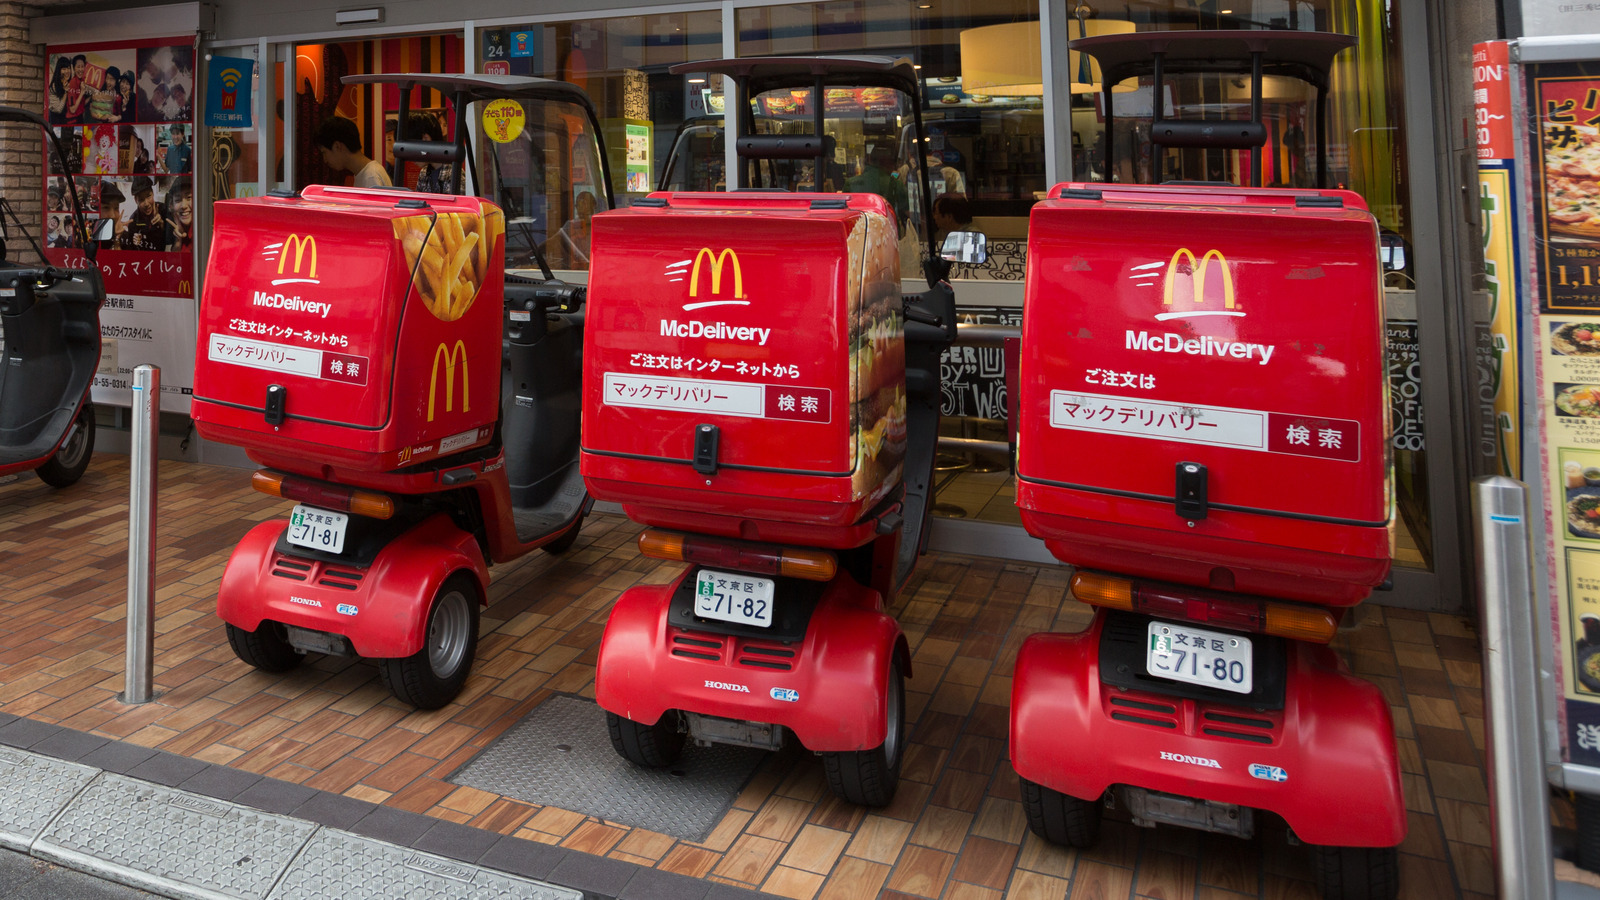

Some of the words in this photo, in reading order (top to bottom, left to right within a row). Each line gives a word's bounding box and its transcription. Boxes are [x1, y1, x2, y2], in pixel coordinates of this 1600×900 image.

[253, 291, 332, 319] McDelivery
[229, 318, 349, 348] ご注文はインターネットから
[660, 319, 771, 346] McDelivery
[216, 342, 296, 364] マックデリバリー
[1125, 329, 1275, 366] McDelivery
[330, 359, 360, 377] 検索
[629, 353, 800, 379] ご注文はインターネットから
[1084, 368, 1157, 390] ご注文は
[613, 382, 729, 404] マックデリバリー
[778, 394, 819, 414] 検索
[1062, 402, 1218, 431] マックデリバリー
[1286, 424, 1343, 450] 検索
[306, 512, 335, 526] 文京区
[716, 579, 755, 594] 文京区
[290, 596, 323, 608] HONDA
[1174, 633, 1225, 653] 文京区
[704, 680, 750, 693] HONDA
[1160, 751, 1223, 769] HONDA
